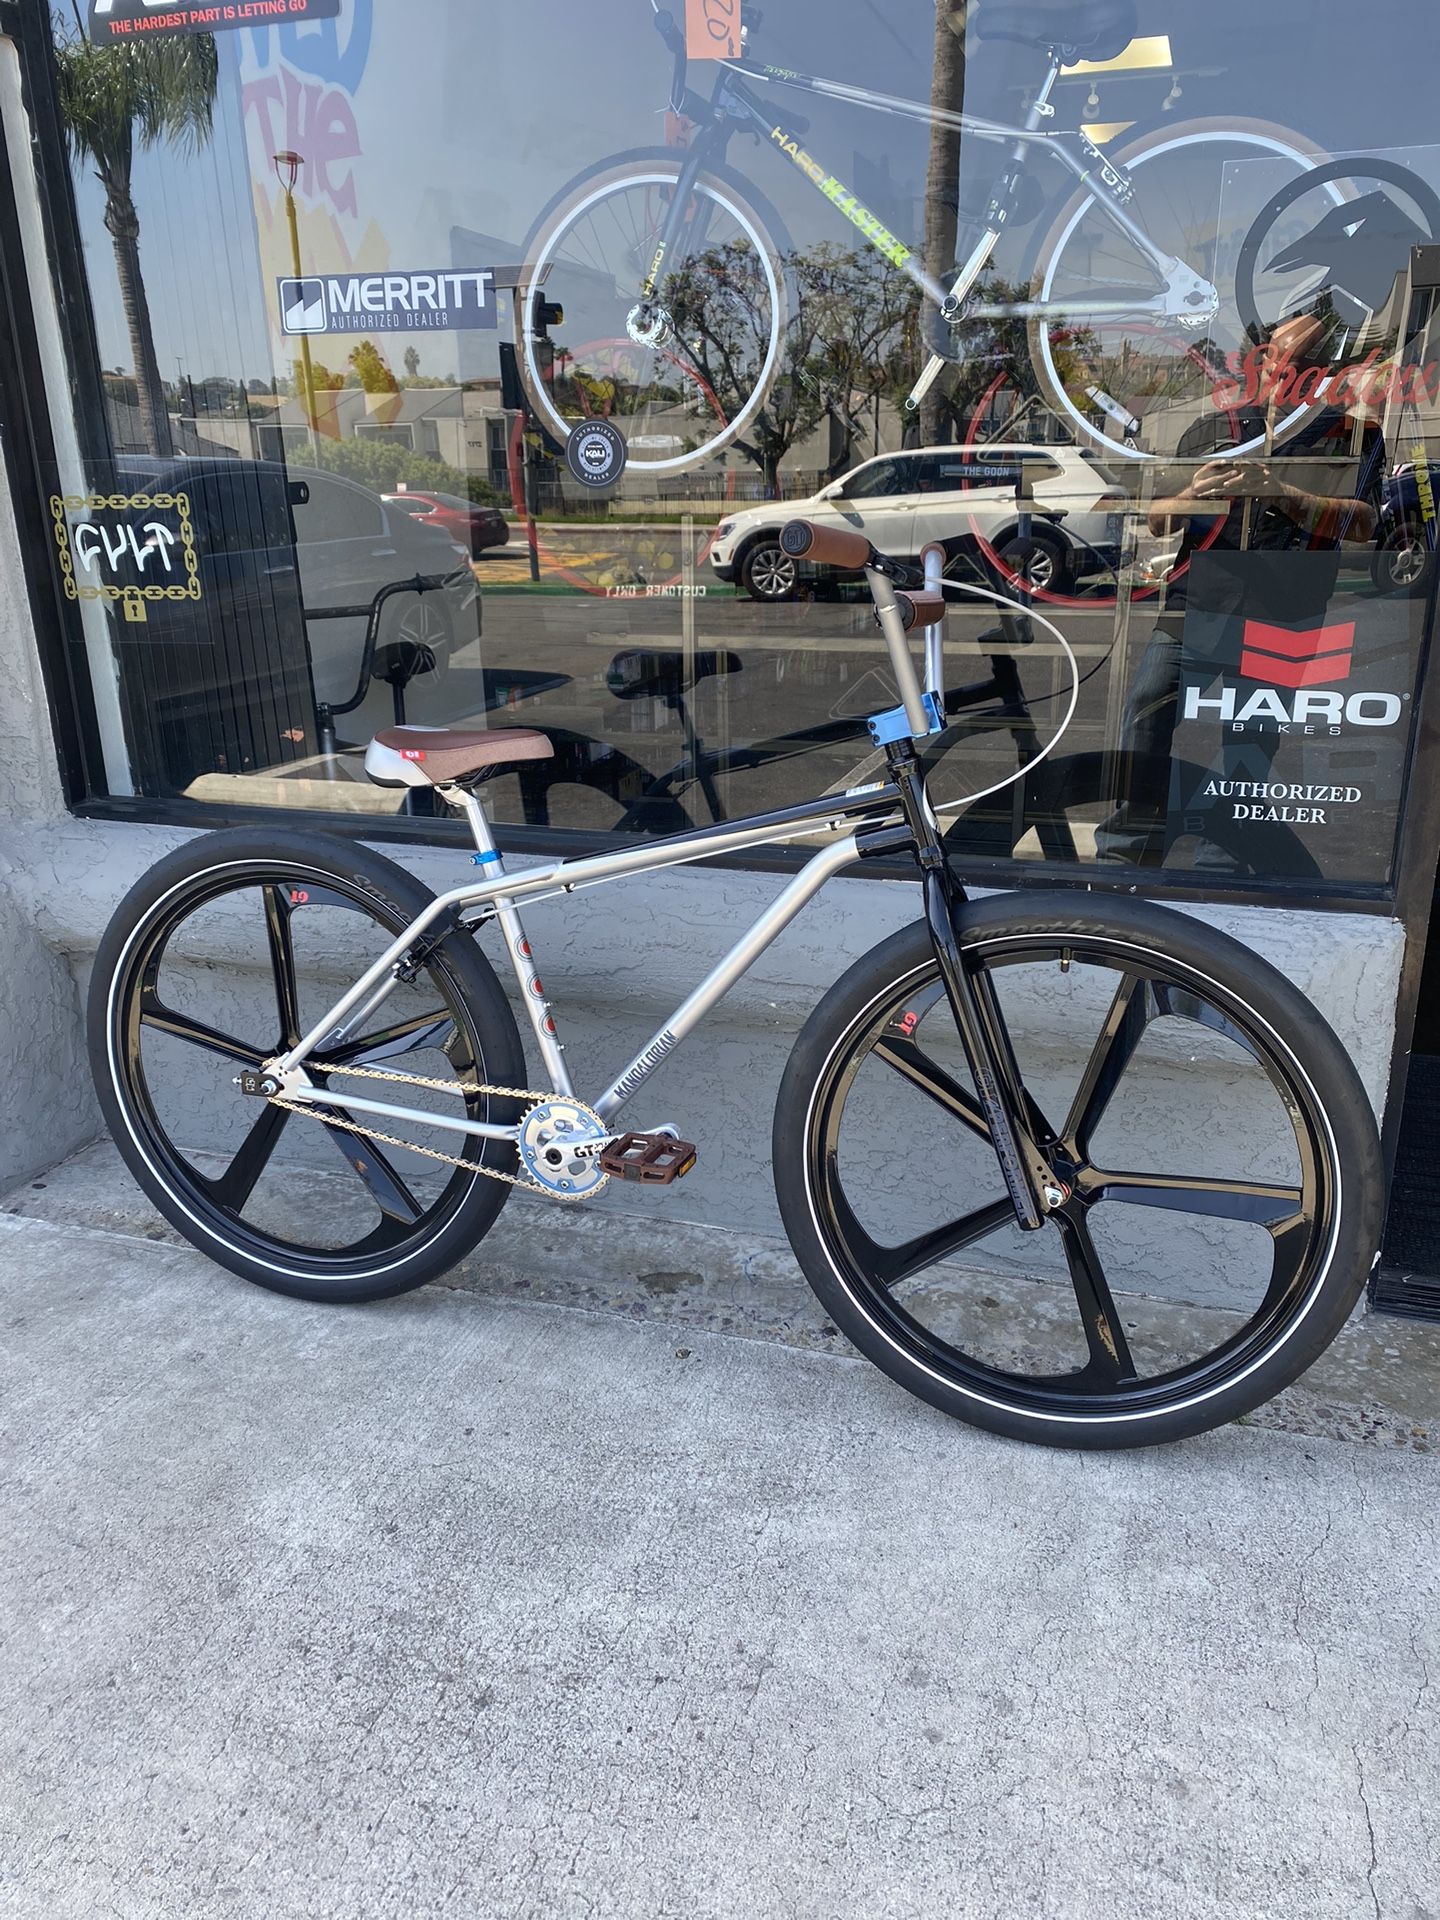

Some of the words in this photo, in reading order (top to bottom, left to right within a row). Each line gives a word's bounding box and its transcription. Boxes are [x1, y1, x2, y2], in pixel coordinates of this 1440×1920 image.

[109, 20, 132, 34] THE
[134, 12, 187, 31] HARDEST
[190, 8, 220, 23] PART
[223, 6, 235, 19] IS
[238, 0, 286, 17] LETTING
[289, 0, 307, 11] GO
[771, 126, 825, 185] HARO
[818, 175, 911, 267] MASTER
[643, 249, 664, 296] HARO
[328, 272, 493, 313] MERRITT
[331, 312, 400, 329] AUTHORIZED
[406, 312, 448, 327] DEALER
[575, 426, 616, 441] AUTHORIZED
[585, 449, 606, 458] KALI
[584, 472, 609, 480] DEALER
[964, 466, 980, 476] THE
[984, 466, 1009, 476] GOON
[1412, 443, 1436, 522] THRONE
[75, 522, 174, 572] CULT
[1184, 687, 1402, 726] HARO
[1232, 722, 1342, 736] BIKES
[1203, 780, 1362, 804] AUTHORIZED
[1232, 803, 1327, 825] DEALER
[614, 1030, 678, 1100] MANDALORIAN
[573, 1145, 594, 1158] GT
